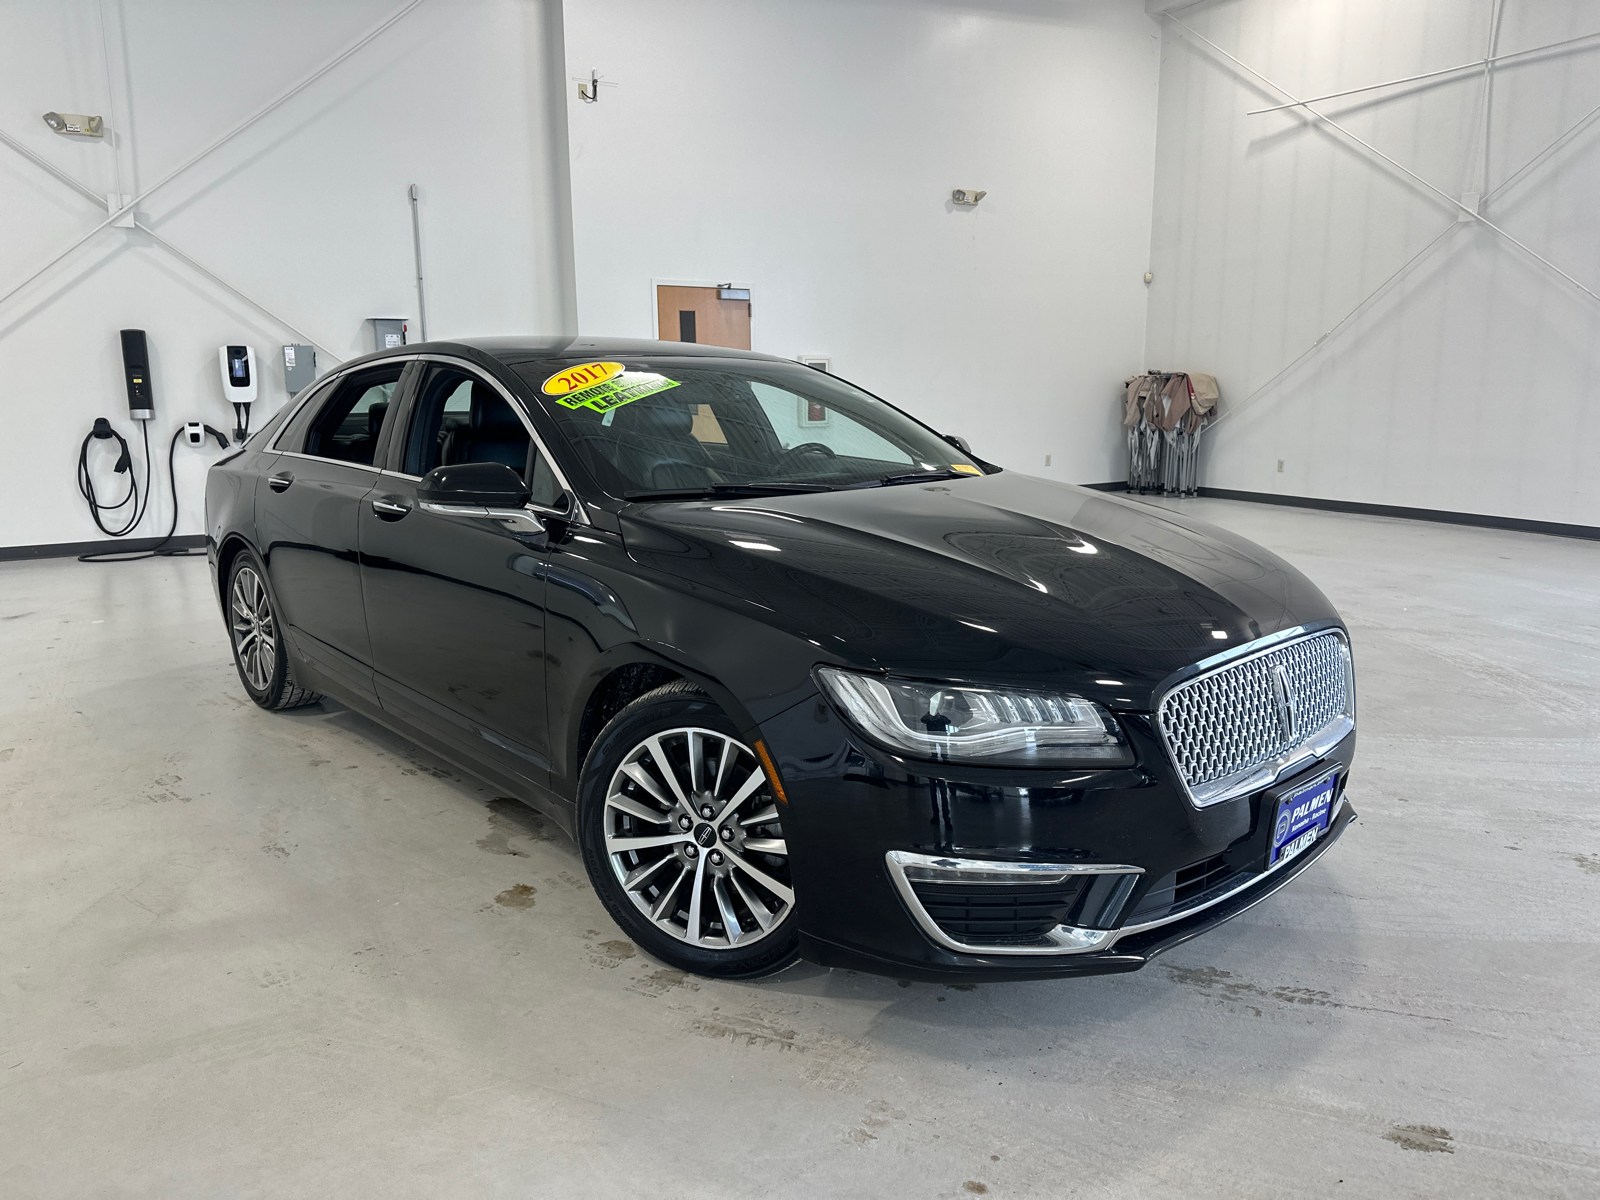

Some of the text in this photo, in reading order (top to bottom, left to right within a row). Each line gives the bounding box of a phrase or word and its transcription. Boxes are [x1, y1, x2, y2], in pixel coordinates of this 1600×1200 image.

[558, 363, 608, 391] 2017
[563, 383, 614, 406] REMOTE
[1291, 788, 1334, 823] PALMEN
[1312, 808, 1327, 821] Racine
[1283, 826, 1319, 860] PALMEN
